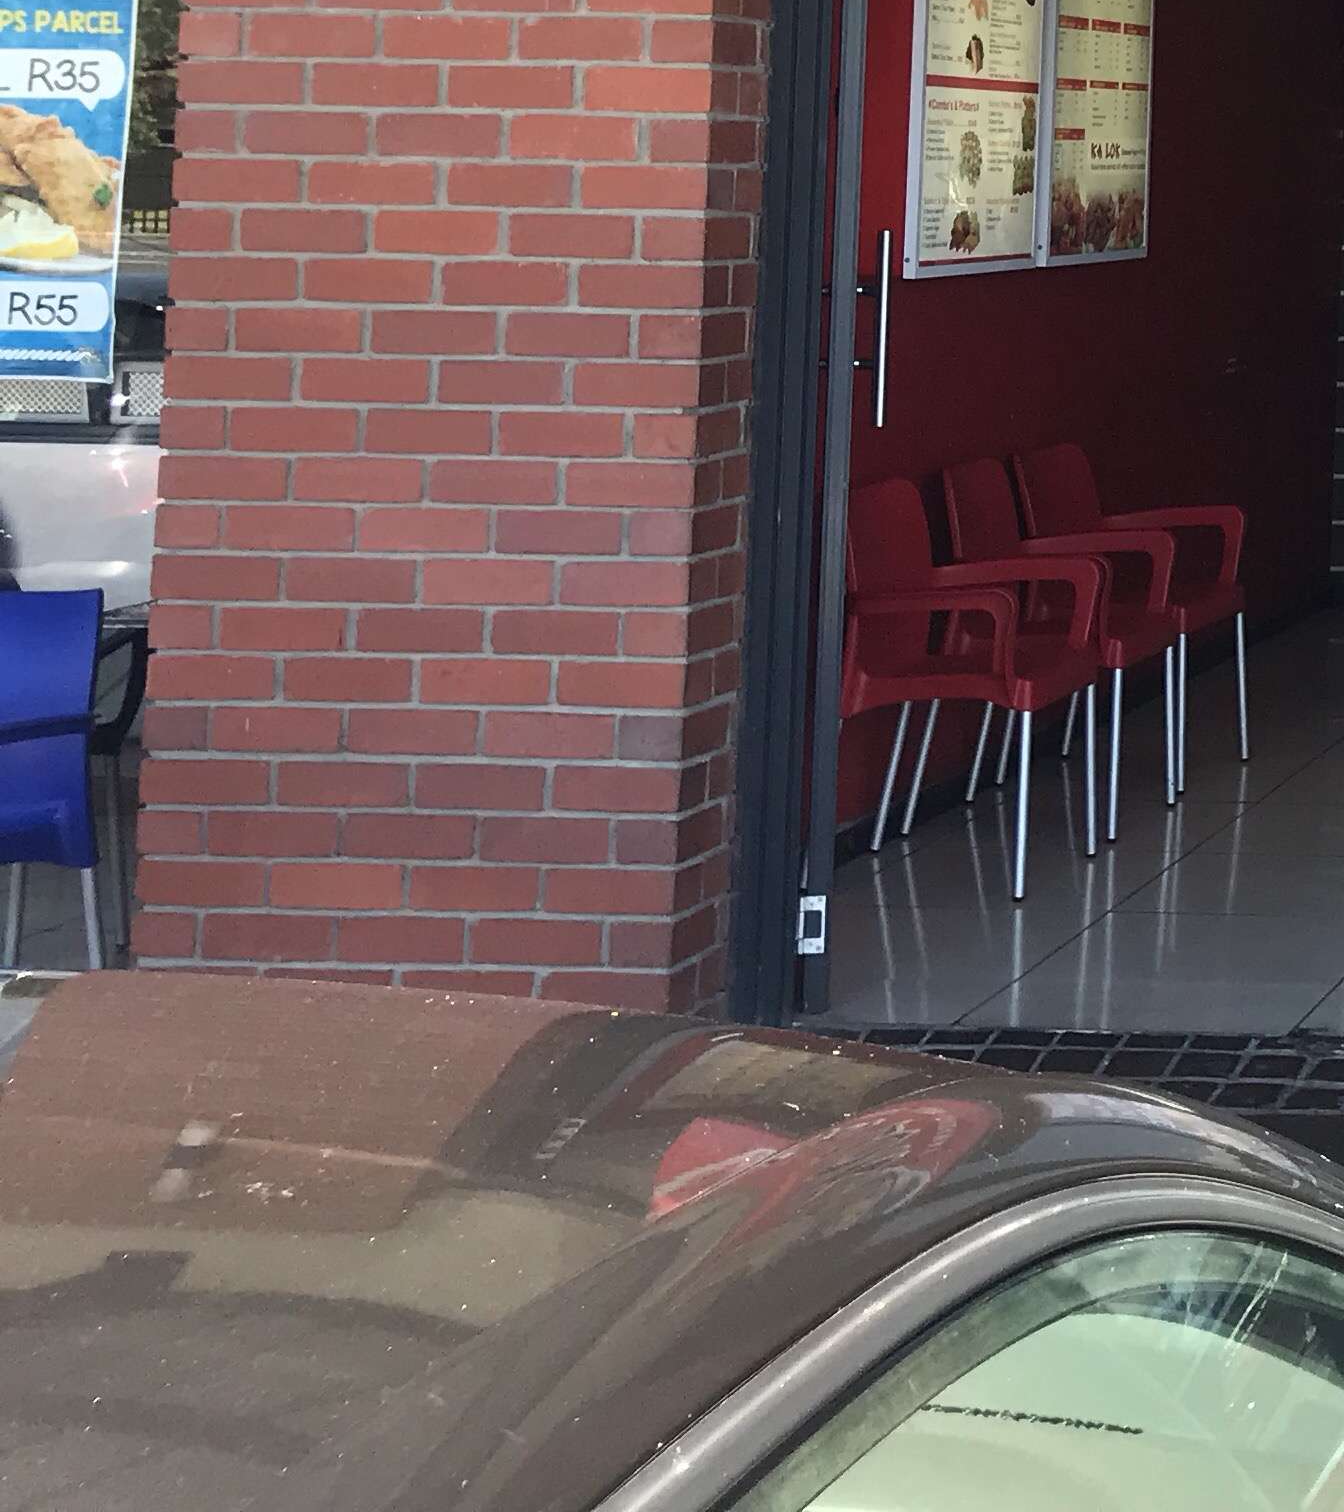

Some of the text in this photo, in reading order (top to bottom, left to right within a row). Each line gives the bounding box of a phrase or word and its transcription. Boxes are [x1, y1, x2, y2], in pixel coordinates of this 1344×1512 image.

[34, 9, 124, 34] PARCEL
[28, 58, 101, 94] R35
[8, 291, 79, 328] R55
